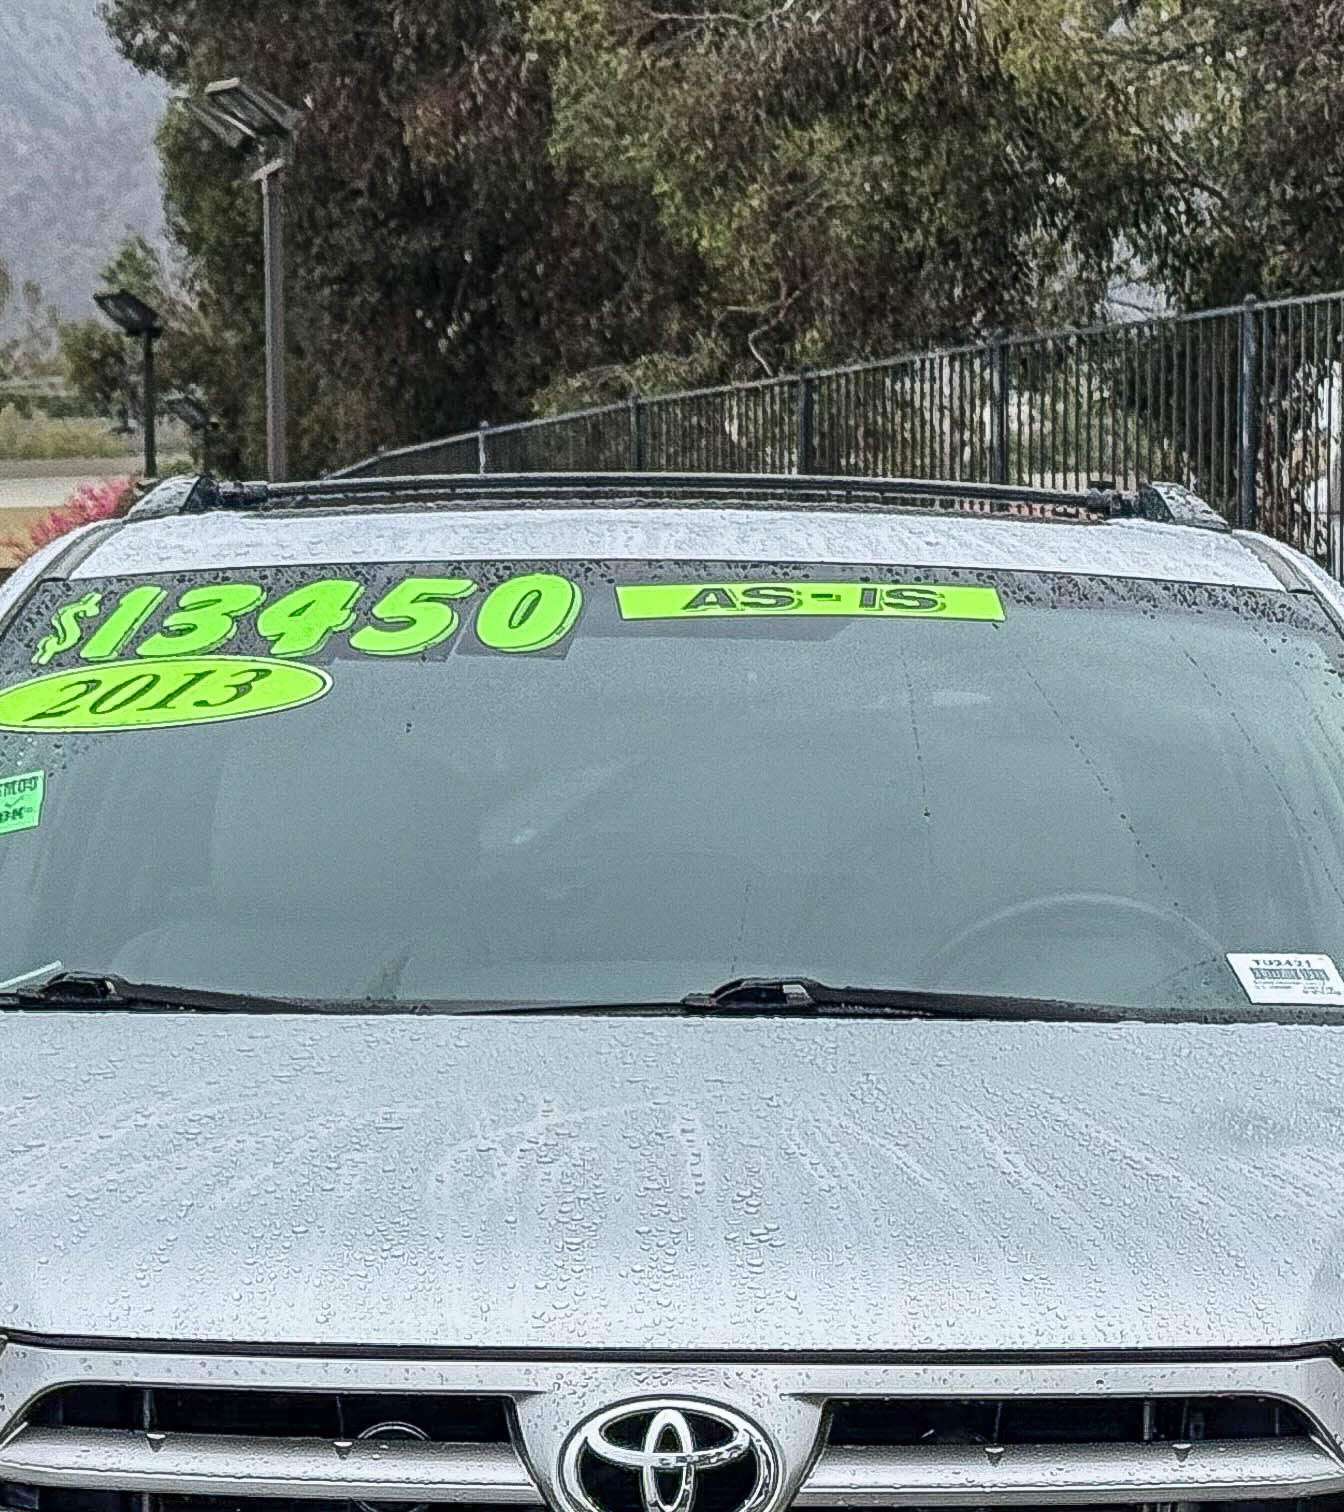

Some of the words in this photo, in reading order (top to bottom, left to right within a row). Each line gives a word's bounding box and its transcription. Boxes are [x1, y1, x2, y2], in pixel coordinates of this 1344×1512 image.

[31, 573, 583, 664] $13450
[682, 586, 946, 613] AS-IS
[23, 667, 272, 722] 2013
